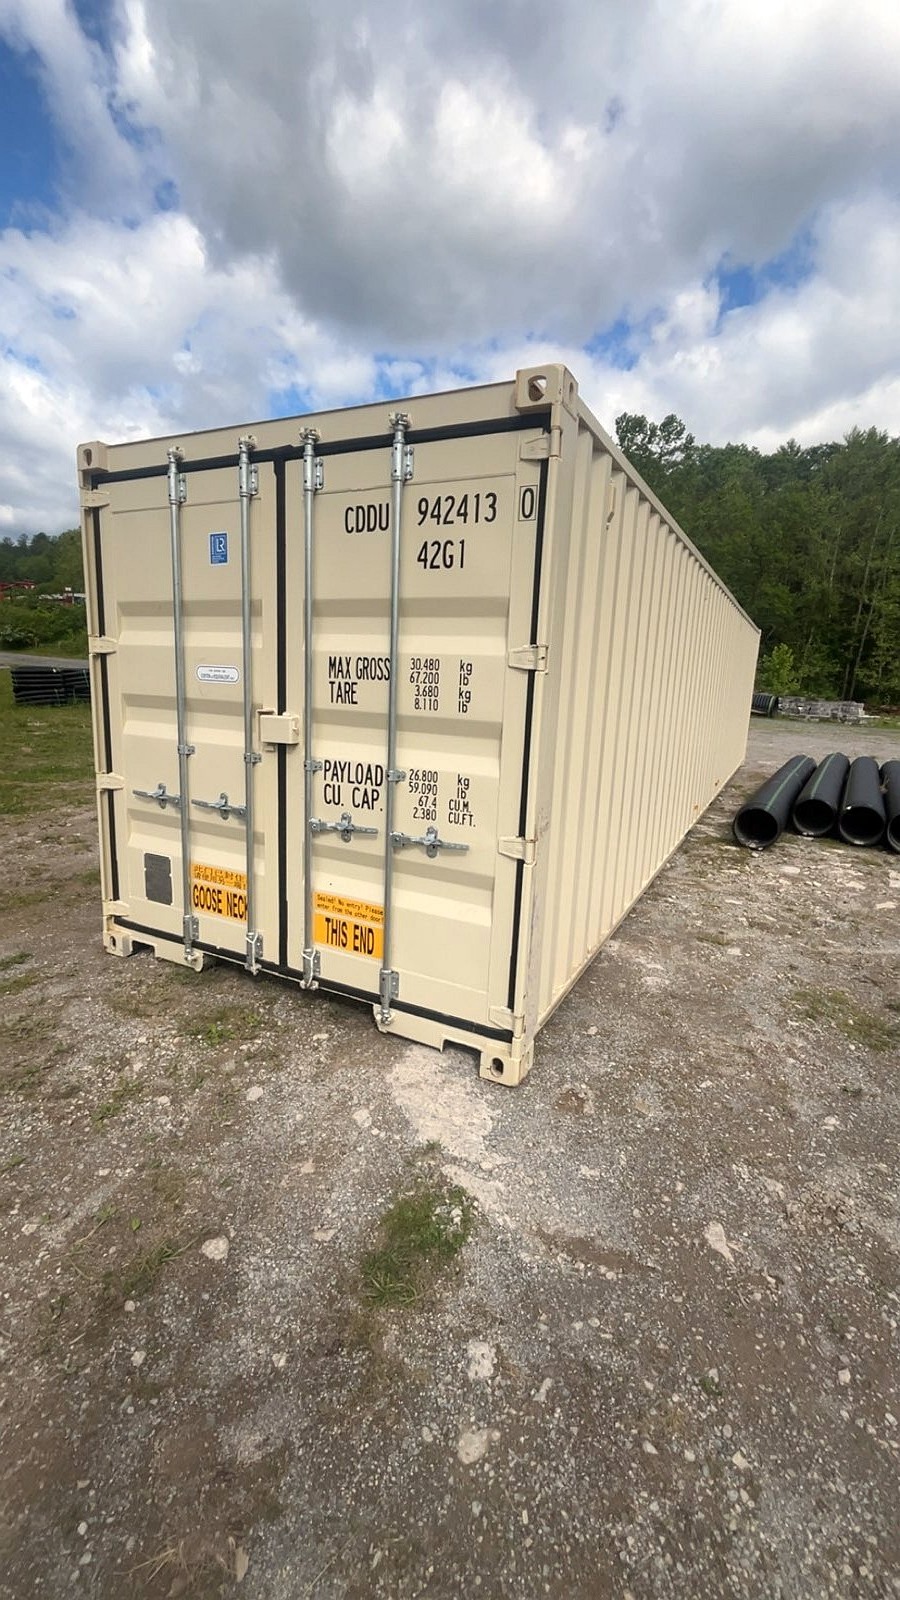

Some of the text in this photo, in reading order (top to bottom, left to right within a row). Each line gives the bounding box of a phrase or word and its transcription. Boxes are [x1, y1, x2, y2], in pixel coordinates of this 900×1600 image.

[344, 487, 535, 534] CDDU 942413 0
[417, 539, 465, 569] 42G1
[328, 656, 473, 681] MAX GROSS 30.480 kg
[409, 671, 469, 686] 67.200 lb
[329, 681, 471, 705] TARE 3.680 kg
[414, 698, 468, 713] 8.110 lb
[324, 759, 470, 790] PAYLOAD 26.800 kg
[324, 783, 345, 807] CU.
[352, 787, 384, 812] CAP.
[418, 796, 437, 809] 67.4
[408, 782, 466, 800] 59.090 lb
[413, 807, 437, 821] 2.380
[193, 884, 222, 914] GOOSE
[325, 917, 375, 955] THIS END
